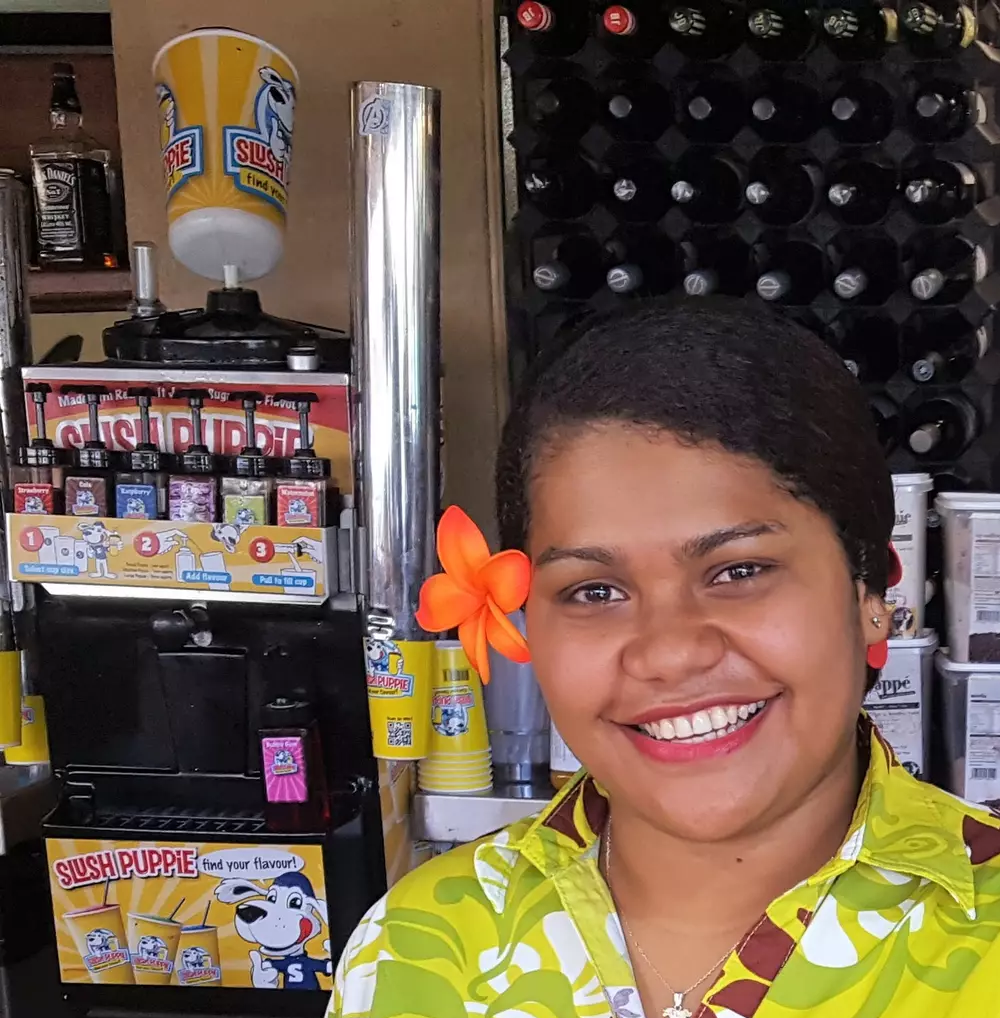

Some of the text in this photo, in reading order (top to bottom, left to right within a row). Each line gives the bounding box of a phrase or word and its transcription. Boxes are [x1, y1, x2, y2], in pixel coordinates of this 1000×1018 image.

[141, 537, 153, 552] 2
[255, 542, 267, 558] 3
[56, 852, 113, 886] SLUSH
[202, 855, 298, 872] find your flavour!
[287, 965, 304, 982] S
